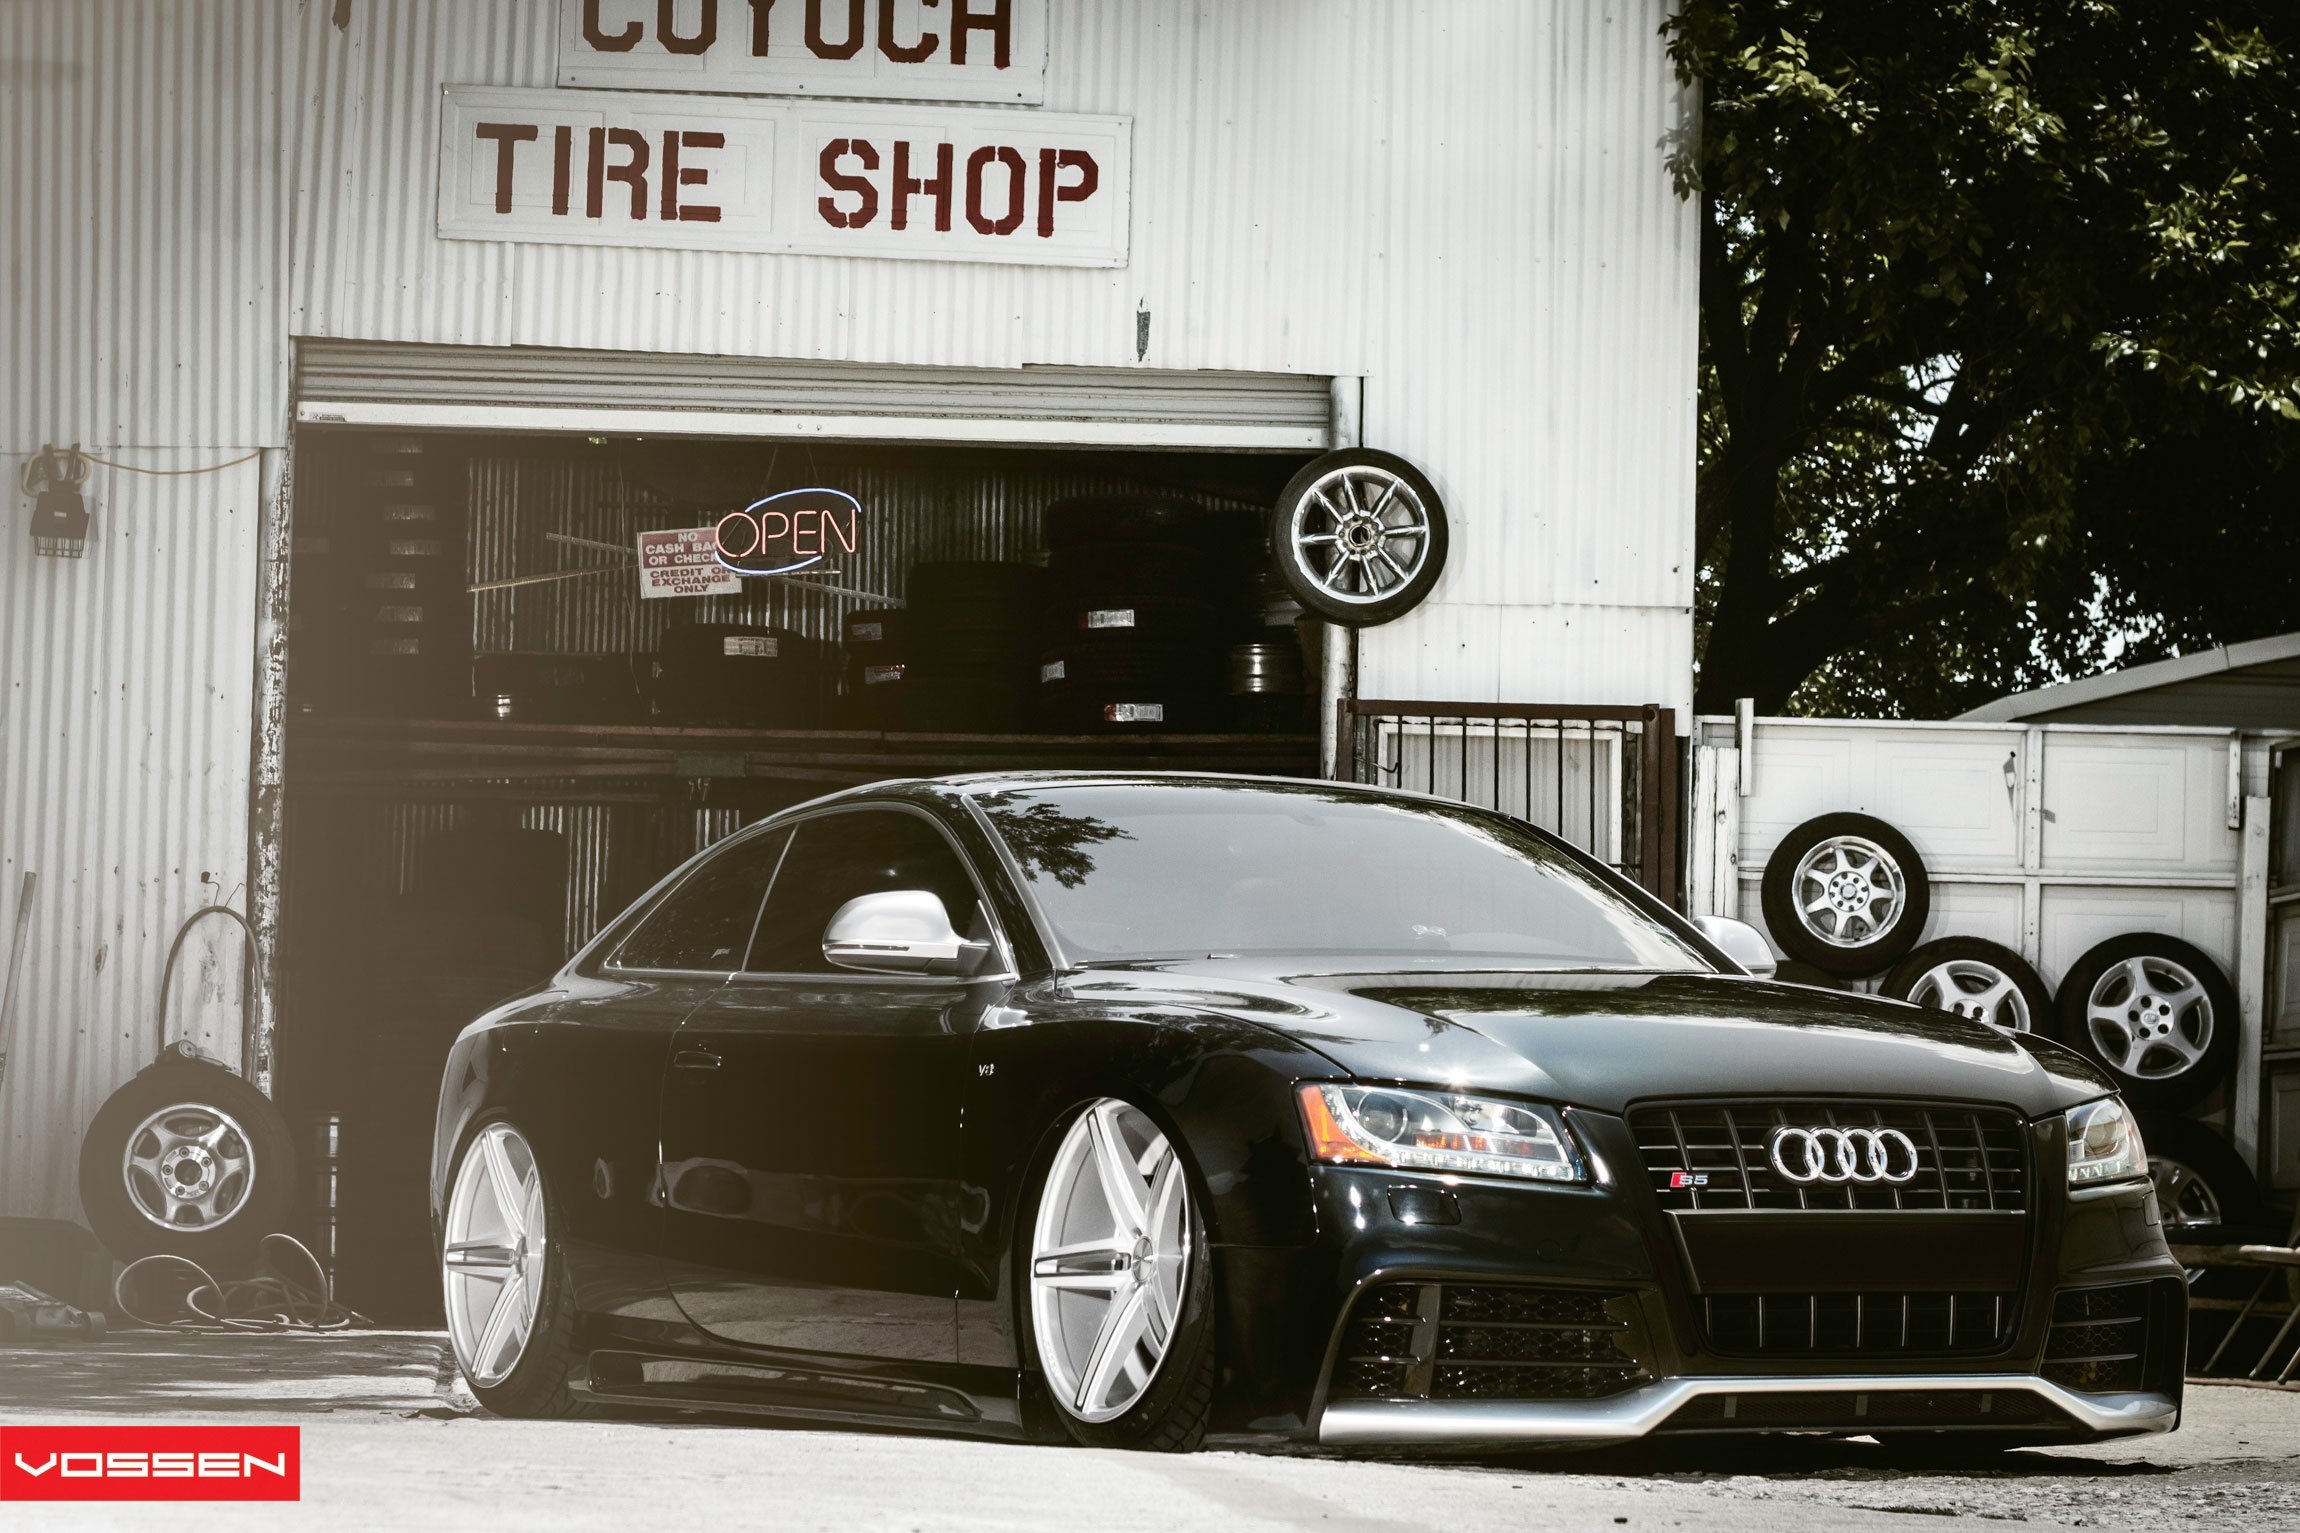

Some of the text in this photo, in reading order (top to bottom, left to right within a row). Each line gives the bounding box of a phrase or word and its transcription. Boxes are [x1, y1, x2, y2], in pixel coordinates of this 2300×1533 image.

[475, 122, 1099, 239] TIRE SHOP
[677, 531, 699, 542] NO
[715, 509, 857, 558] OPEN
[645, 542, 685, 554] CASH
[648, 555, 669, 566] OR
[650, 567, 704, 578] CREDIT
[651, 574, 731, 587] EXCHANGE
[673, 583, 709, 594] ONLY
[1679, 1174, 1709, 1186] S5
